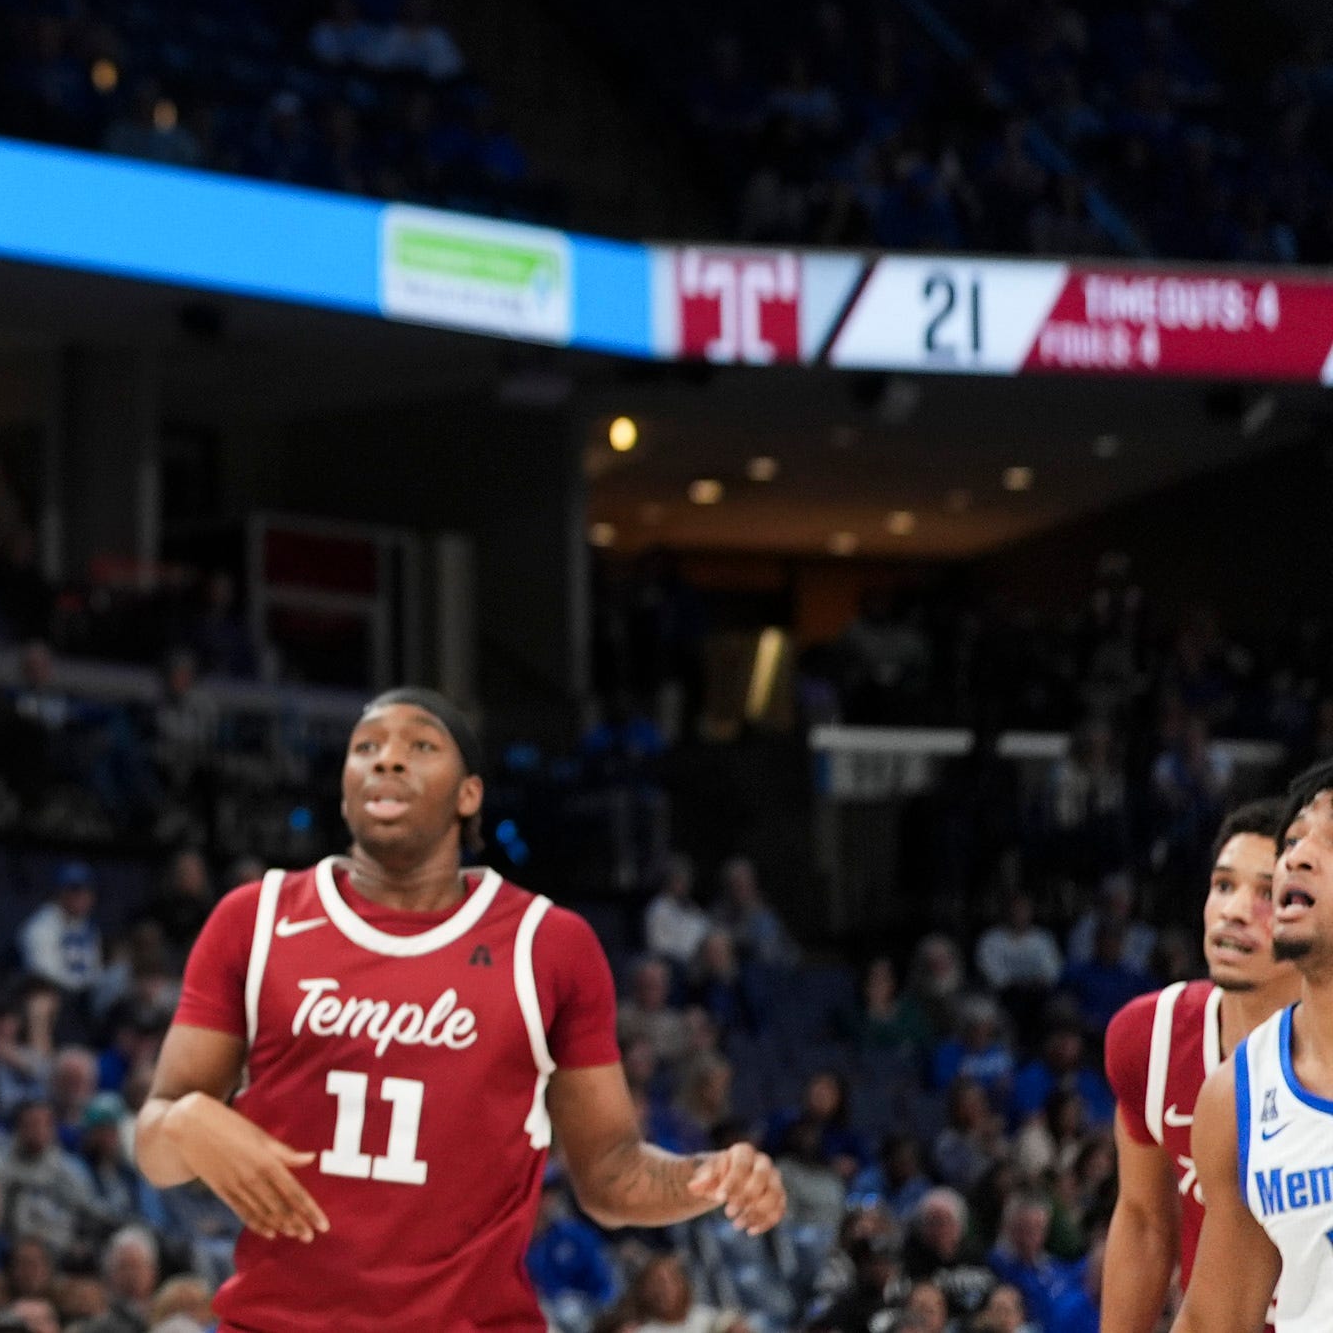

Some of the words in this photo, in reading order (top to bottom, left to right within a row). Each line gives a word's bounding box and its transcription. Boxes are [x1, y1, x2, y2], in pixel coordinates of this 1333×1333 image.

[921, 272, 984, 363] 21
[291, 978, 478, 1057] Temple
[319, 1070, 428, 1185] 11
